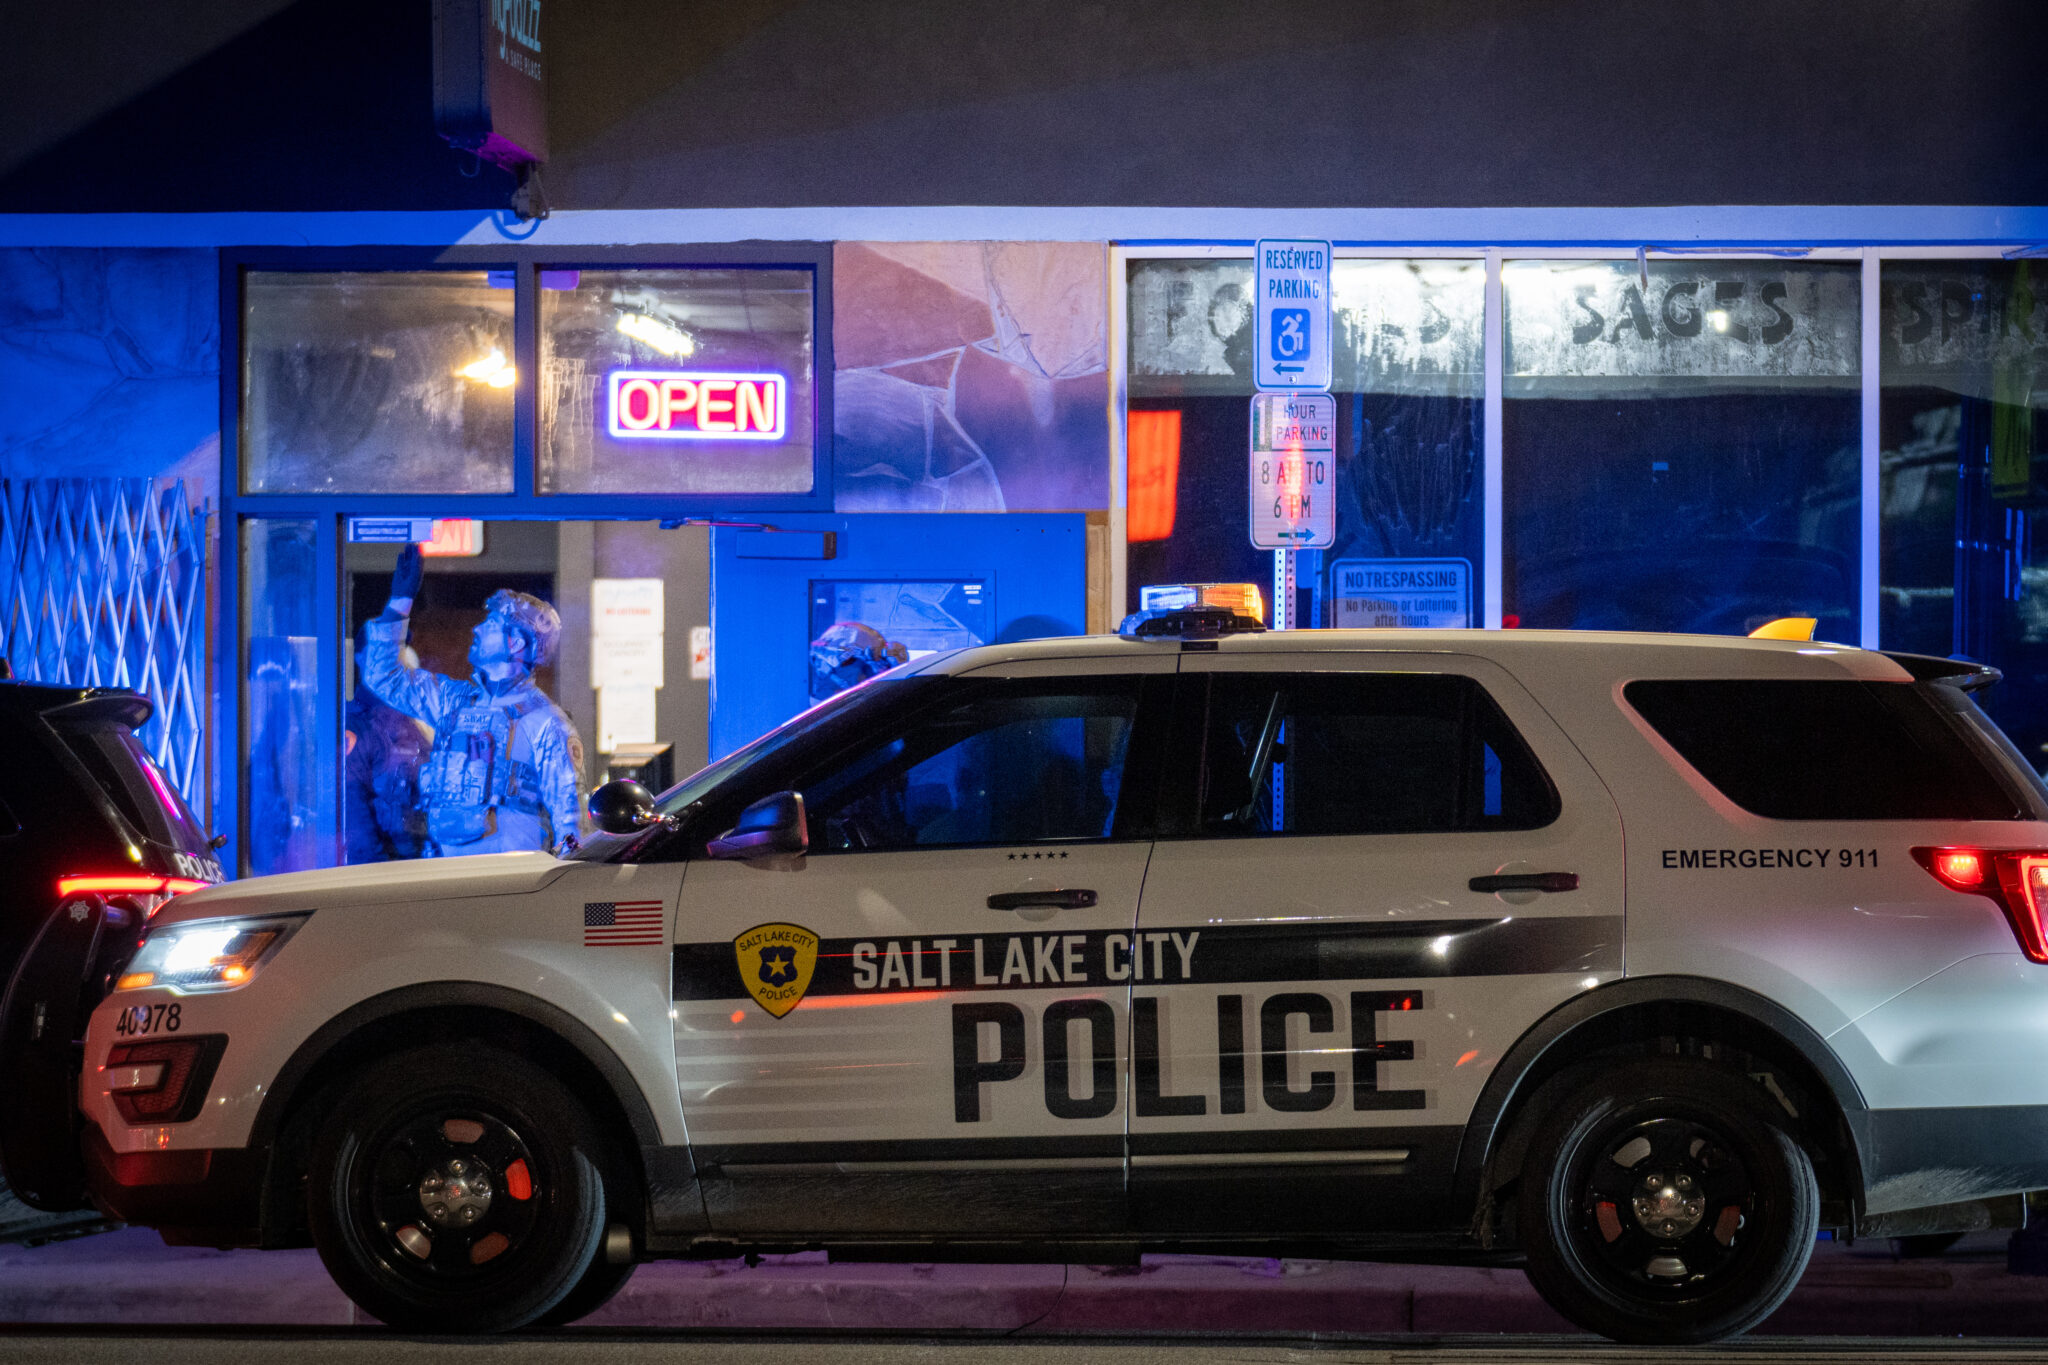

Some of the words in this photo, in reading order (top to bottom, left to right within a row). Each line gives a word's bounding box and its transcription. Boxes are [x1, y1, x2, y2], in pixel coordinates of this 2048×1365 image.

[1266, 250, 1323, 270] RESERVED
[1269, 279, 1320, 299] PARKING
[1572, 281, 1795, 345] SAGES
[618, 378, 776, 432] OPEN
[1284, 405, 1317, 420] HOUR
[1276, 426, 1328, 441] PARKING
[1262, 461, 1270, 485] 8
[1306, 461, 1325, 485] TO
[1274, 496, 1282, 518] 6
[1345, 571, 1364, 588] NO
[1365, 571, 1457, 588] TRESPASSING
[1346, 600, 1358, 612] No
[1362, 600, 1397, 613] Parking
[1401, 602, 1411, 611] or
[1414, 599, 1457, 613] Loitering
[1375, 613, 1397, 627] after
[1401, 614, 1430, 627] hours
[1662, 849, 1831, 868] EMERGENCY
[1839, 849, 1879, 868] 911
[740, 934, 762, 951] SALT
[763, 931, 791, 942] LAKE
[792, 933, 814, 949] CITY
[851, 937, 958, 989] SALT
[973, 934, 1088, 986] LAKE
[1105, 931, 1200, 981] CITY
[759, 986, 798, 1000] POLICE
[116, 1002, 182, 1037] 40978
[951, 988, 1428, 1123] POLICE
